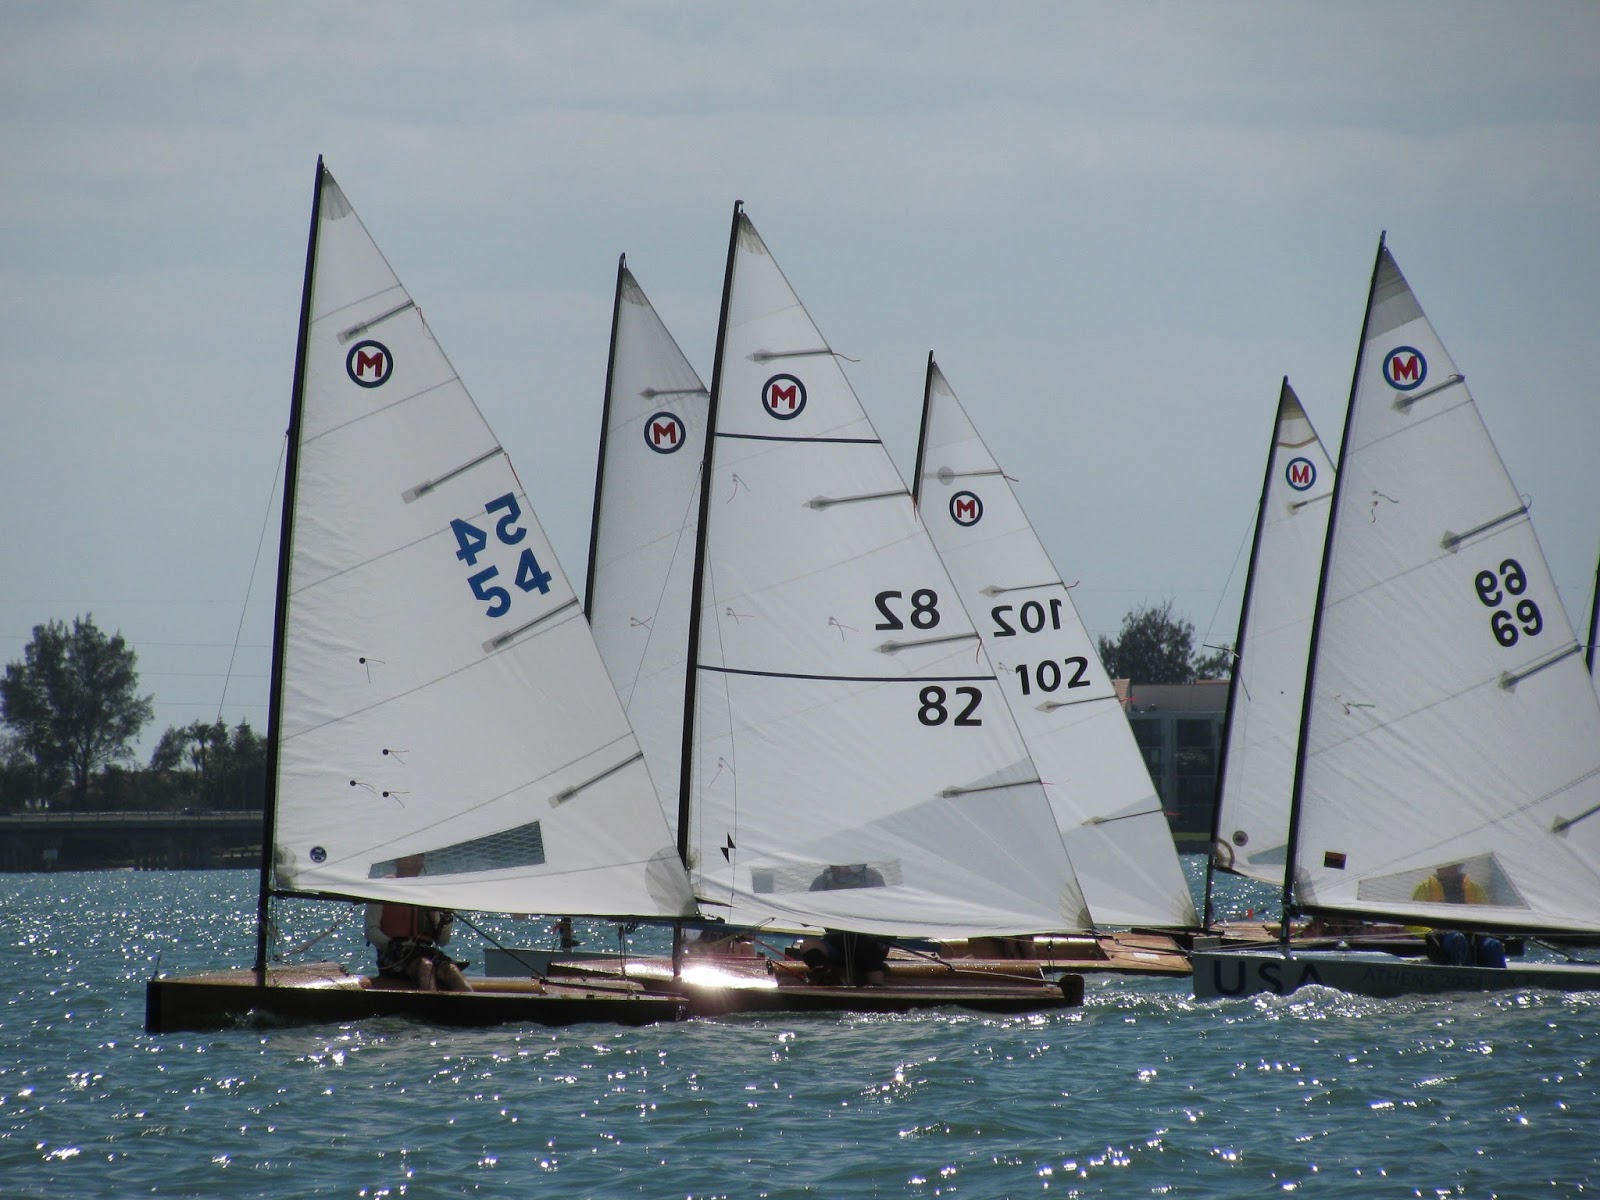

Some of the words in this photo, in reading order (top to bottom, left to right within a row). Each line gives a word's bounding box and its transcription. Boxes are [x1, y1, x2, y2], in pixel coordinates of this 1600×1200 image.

[467, 547, 552, 618] 54
[1491, 599, 1543, 647] 69
[1015, 656, 1091, 696] 102
[917, 685, 983, 727] 82
[1213, 958, 1325, 996] USA
[1362, 967, 1434, 988] ATHENS
